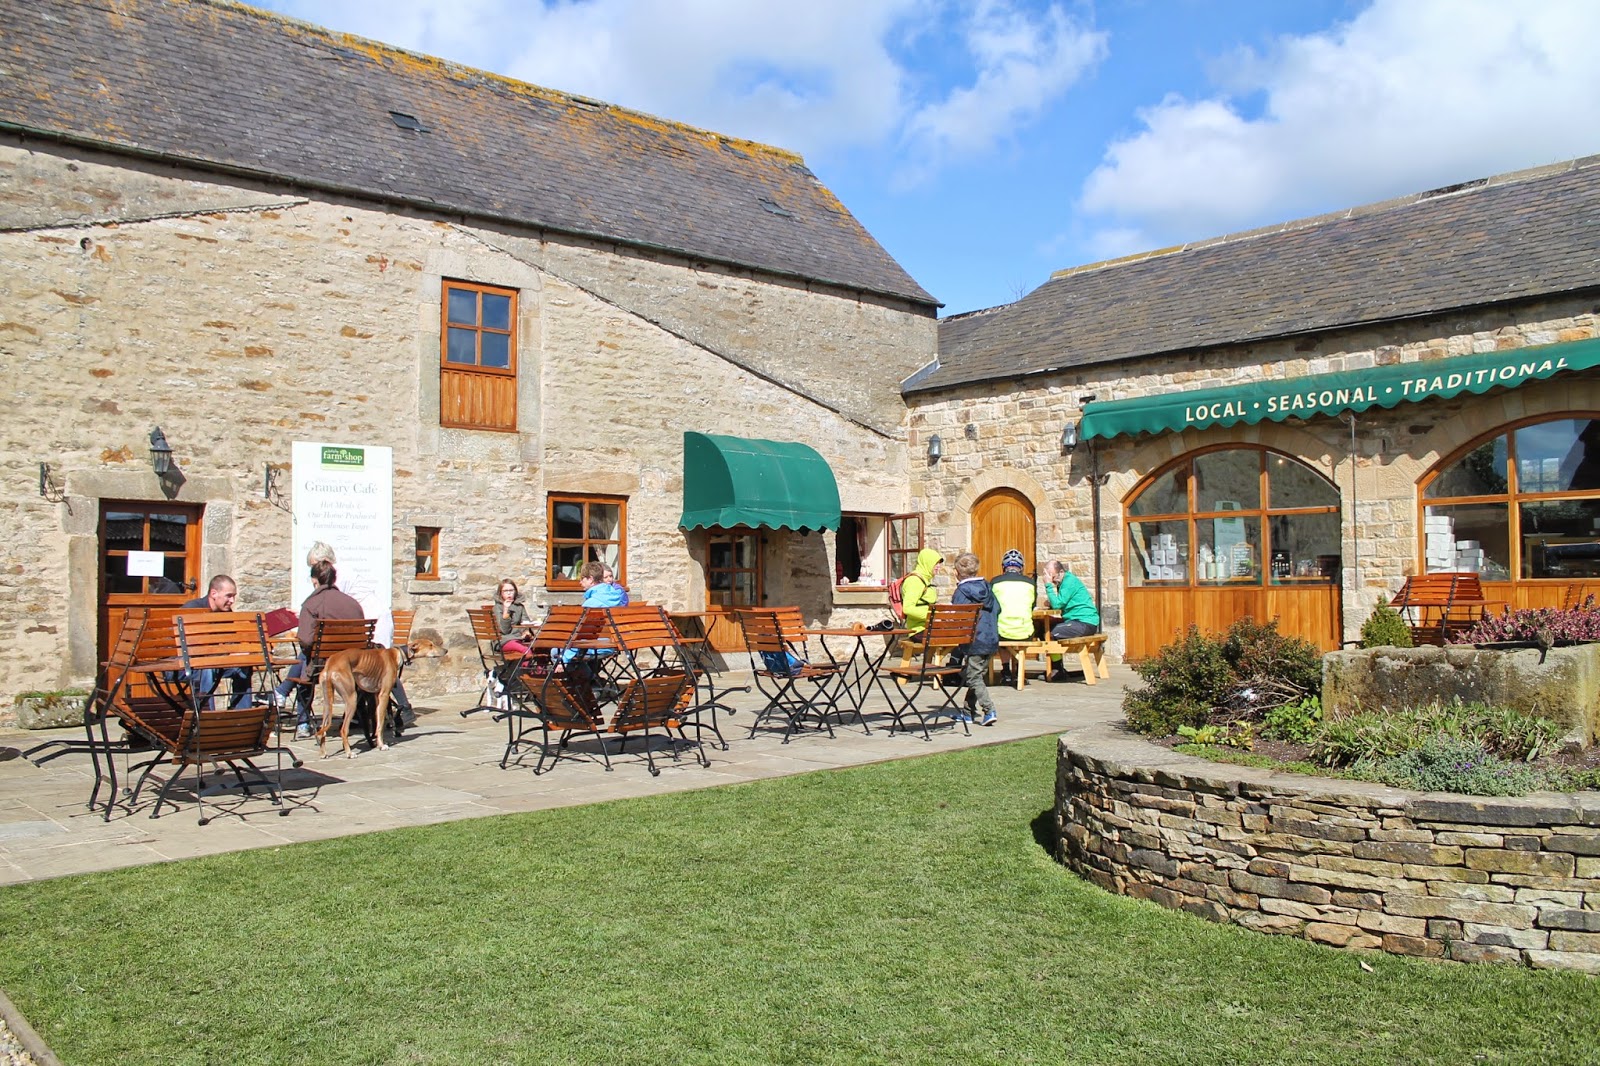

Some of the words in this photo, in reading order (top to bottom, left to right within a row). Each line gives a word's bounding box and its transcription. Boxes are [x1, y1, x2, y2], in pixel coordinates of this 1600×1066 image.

[1185, 401, 1247, 422] LOCAL
[1267, 385, 1377, 413] SEASONAL
[1401, 357, 1569, 396] TRADITIONAL
[323, 450, 342, 460] farm
[345, 452, 363, 464] shop
[304, 481, 350, 496] Granary
[353, 482, 378, 494] Café
